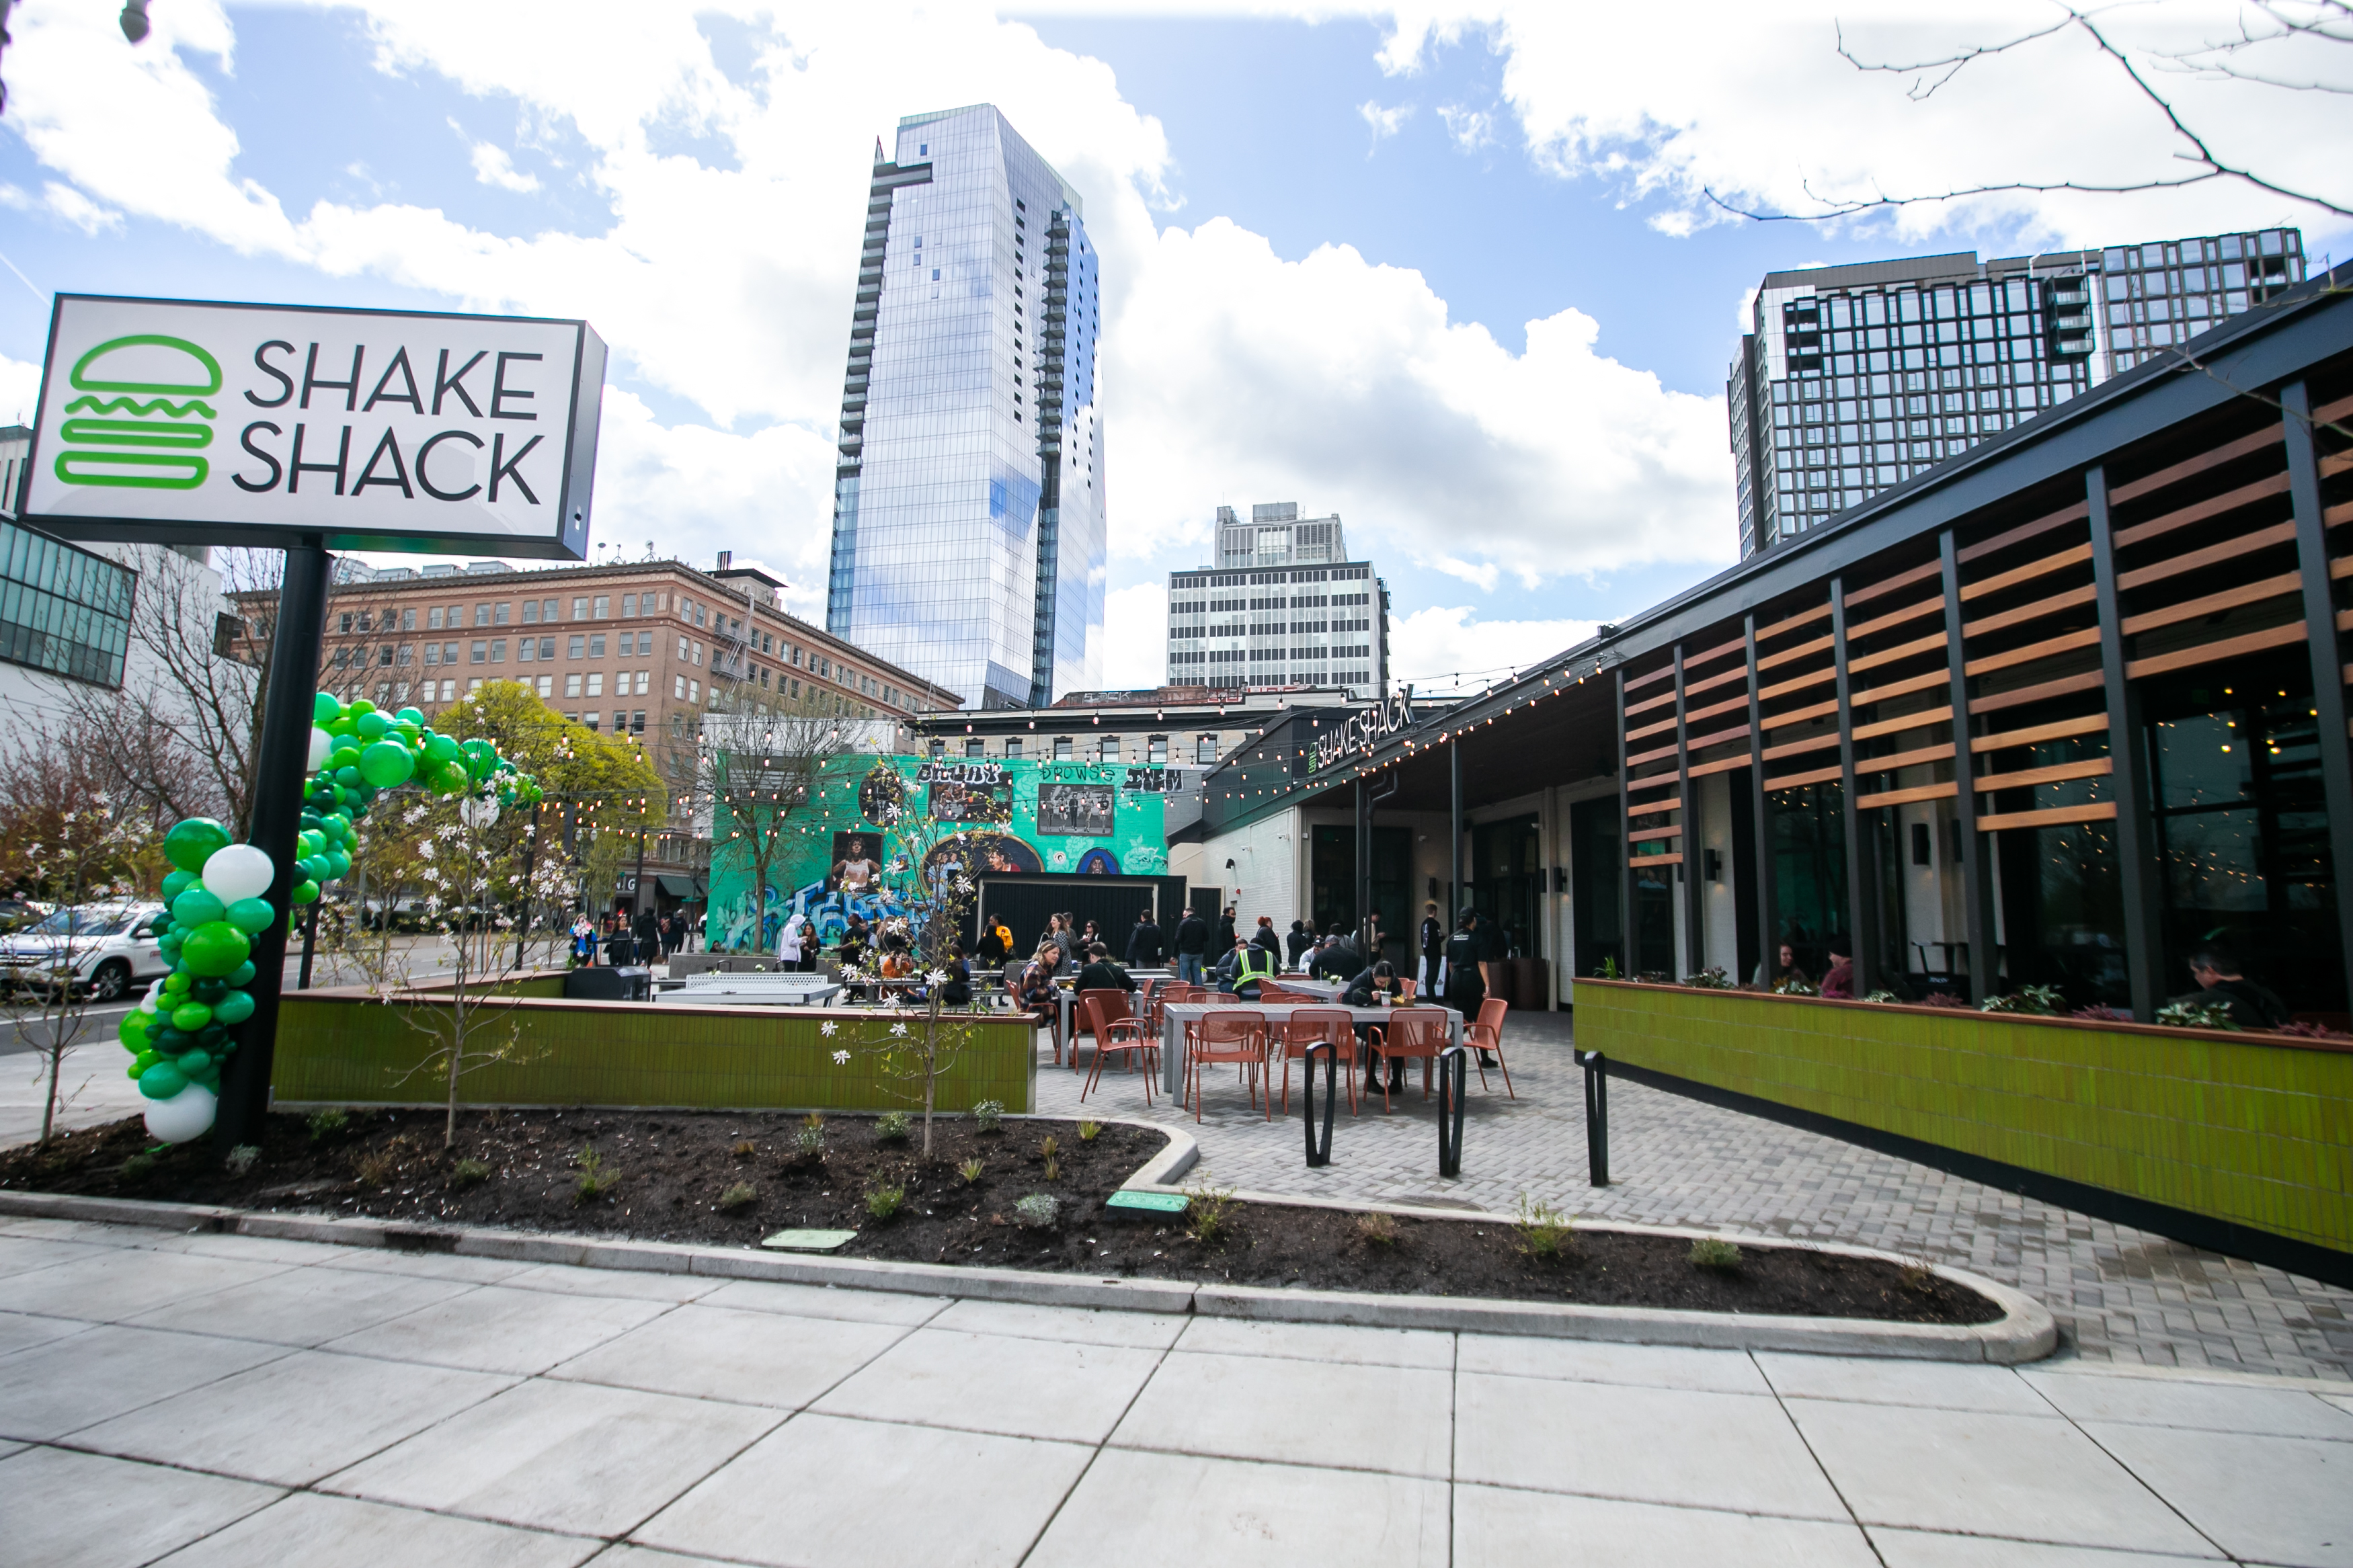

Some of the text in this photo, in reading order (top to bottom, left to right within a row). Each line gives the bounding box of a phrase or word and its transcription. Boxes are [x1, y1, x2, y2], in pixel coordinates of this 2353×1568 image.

[243, 339, 544, 420] SHAKE
[231, 421, 545, 505] SHACK
[1318, 684, 1414, 769] SHAKE SHACK
